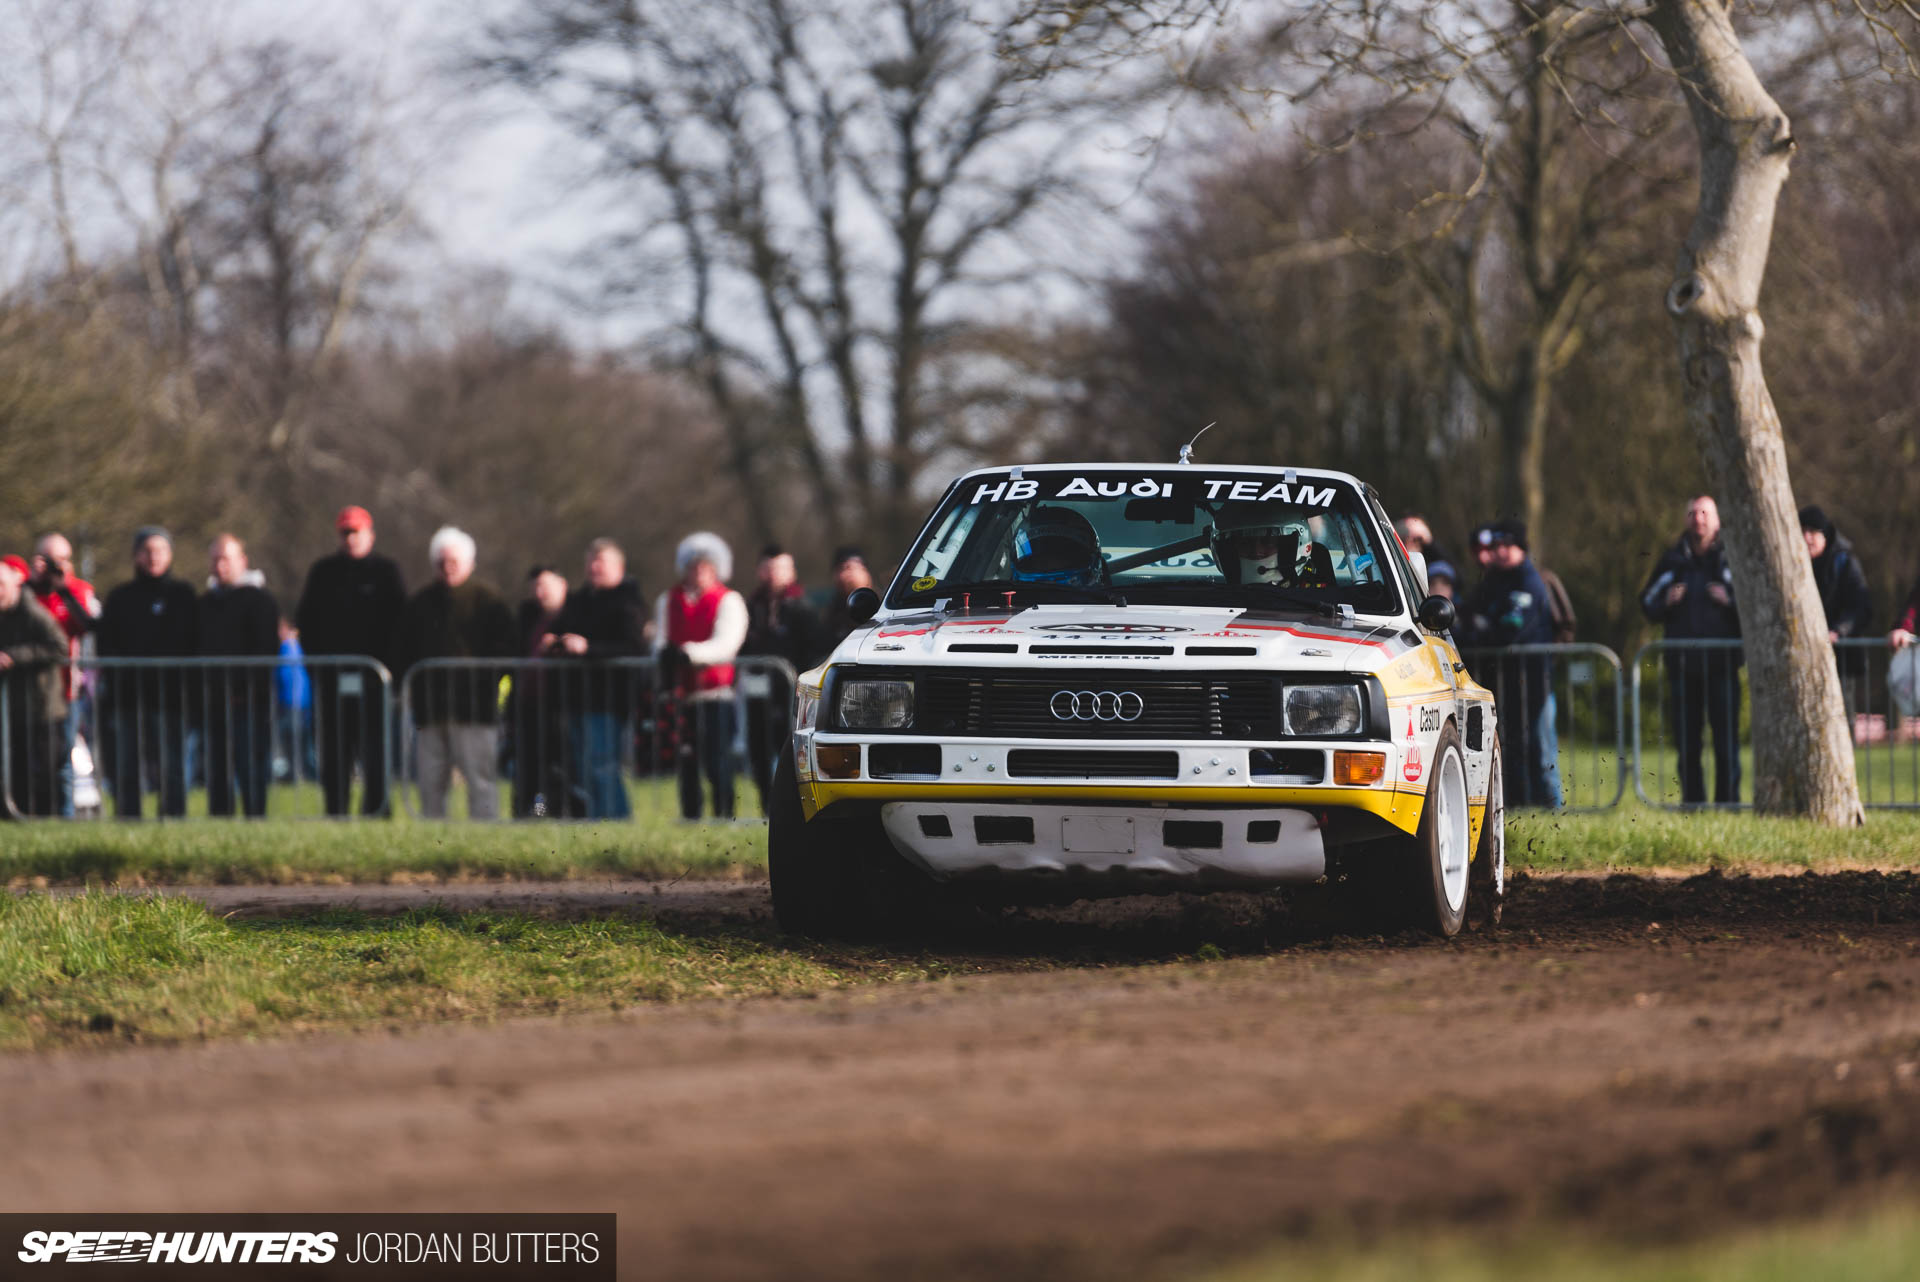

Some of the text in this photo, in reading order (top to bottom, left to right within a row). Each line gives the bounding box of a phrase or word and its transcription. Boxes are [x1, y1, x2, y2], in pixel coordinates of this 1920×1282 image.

[970, 478, 1336, 507] HB Audi TEAM
